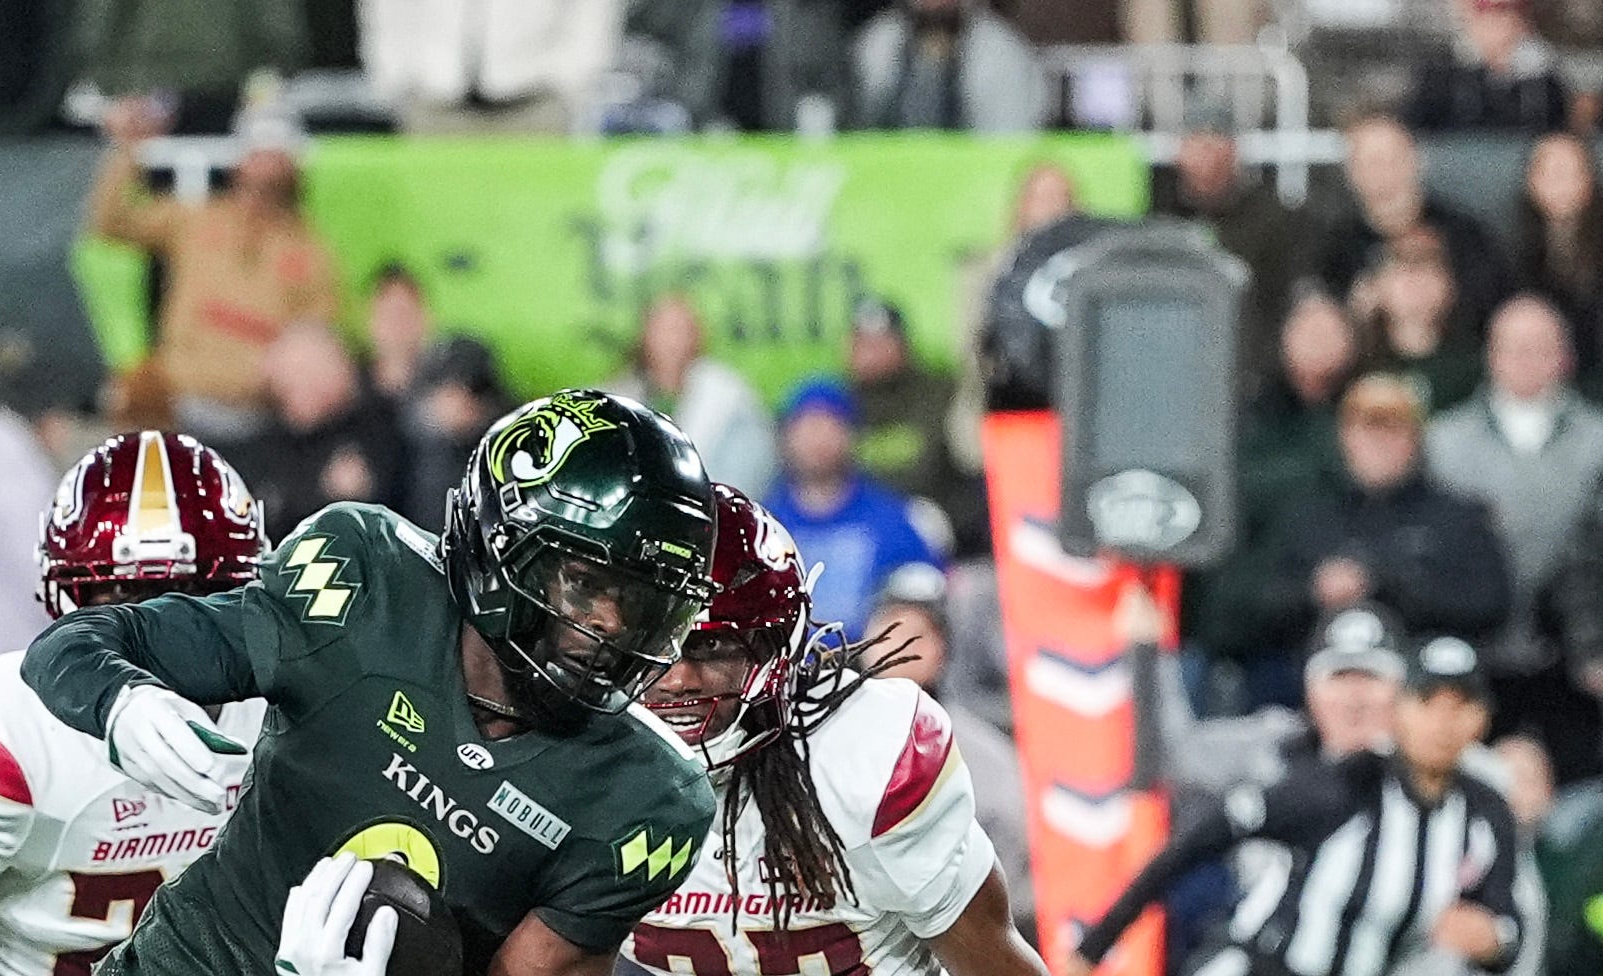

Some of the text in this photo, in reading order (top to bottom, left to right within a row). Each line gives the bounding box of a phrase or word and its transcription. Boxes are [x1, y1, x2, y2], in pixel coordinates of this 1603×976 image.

[460, 746, 488, 768] UFL
[382, 752, 500, 855] KINGS
[493, 786, 566, 846] NOBULL
[92, 826, 217, 861] BIRMING
[654, 891, 825, 915] RMINGHA
